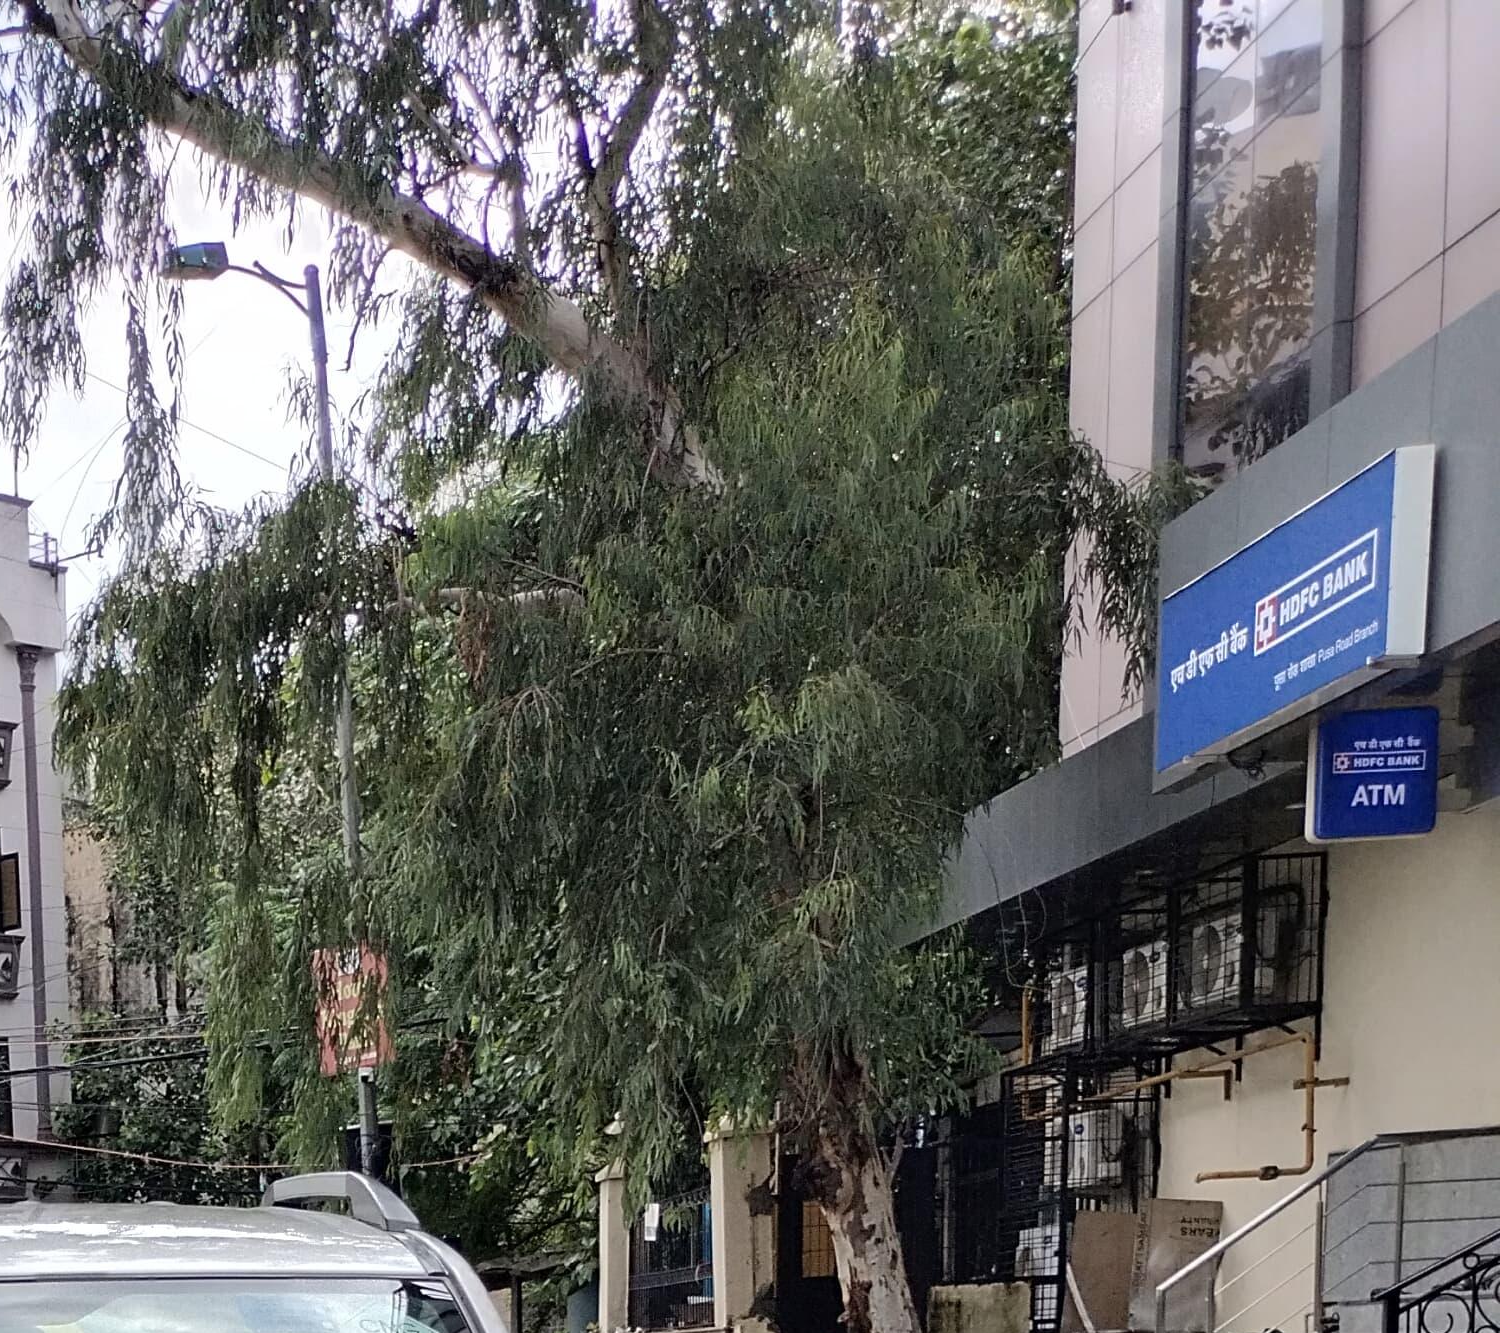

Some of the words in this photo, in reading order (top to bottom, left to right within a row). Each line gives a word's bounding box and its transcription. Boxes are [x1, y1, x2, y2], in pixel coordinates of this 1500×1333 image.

[1279, 581, 1321, 626] HDFC
[1322, 551, 1369, 601] BANK
[1317, 645, 1335, 663] Pusa
[1335, 632, 1353, 653] Road
[1354, 619, 1379, 643] Branch
[1353, 756, 1385, 768] HDFC
[1387, 755, 1420, 766] BANK
[1350, 783, 1405, 807] ATM
